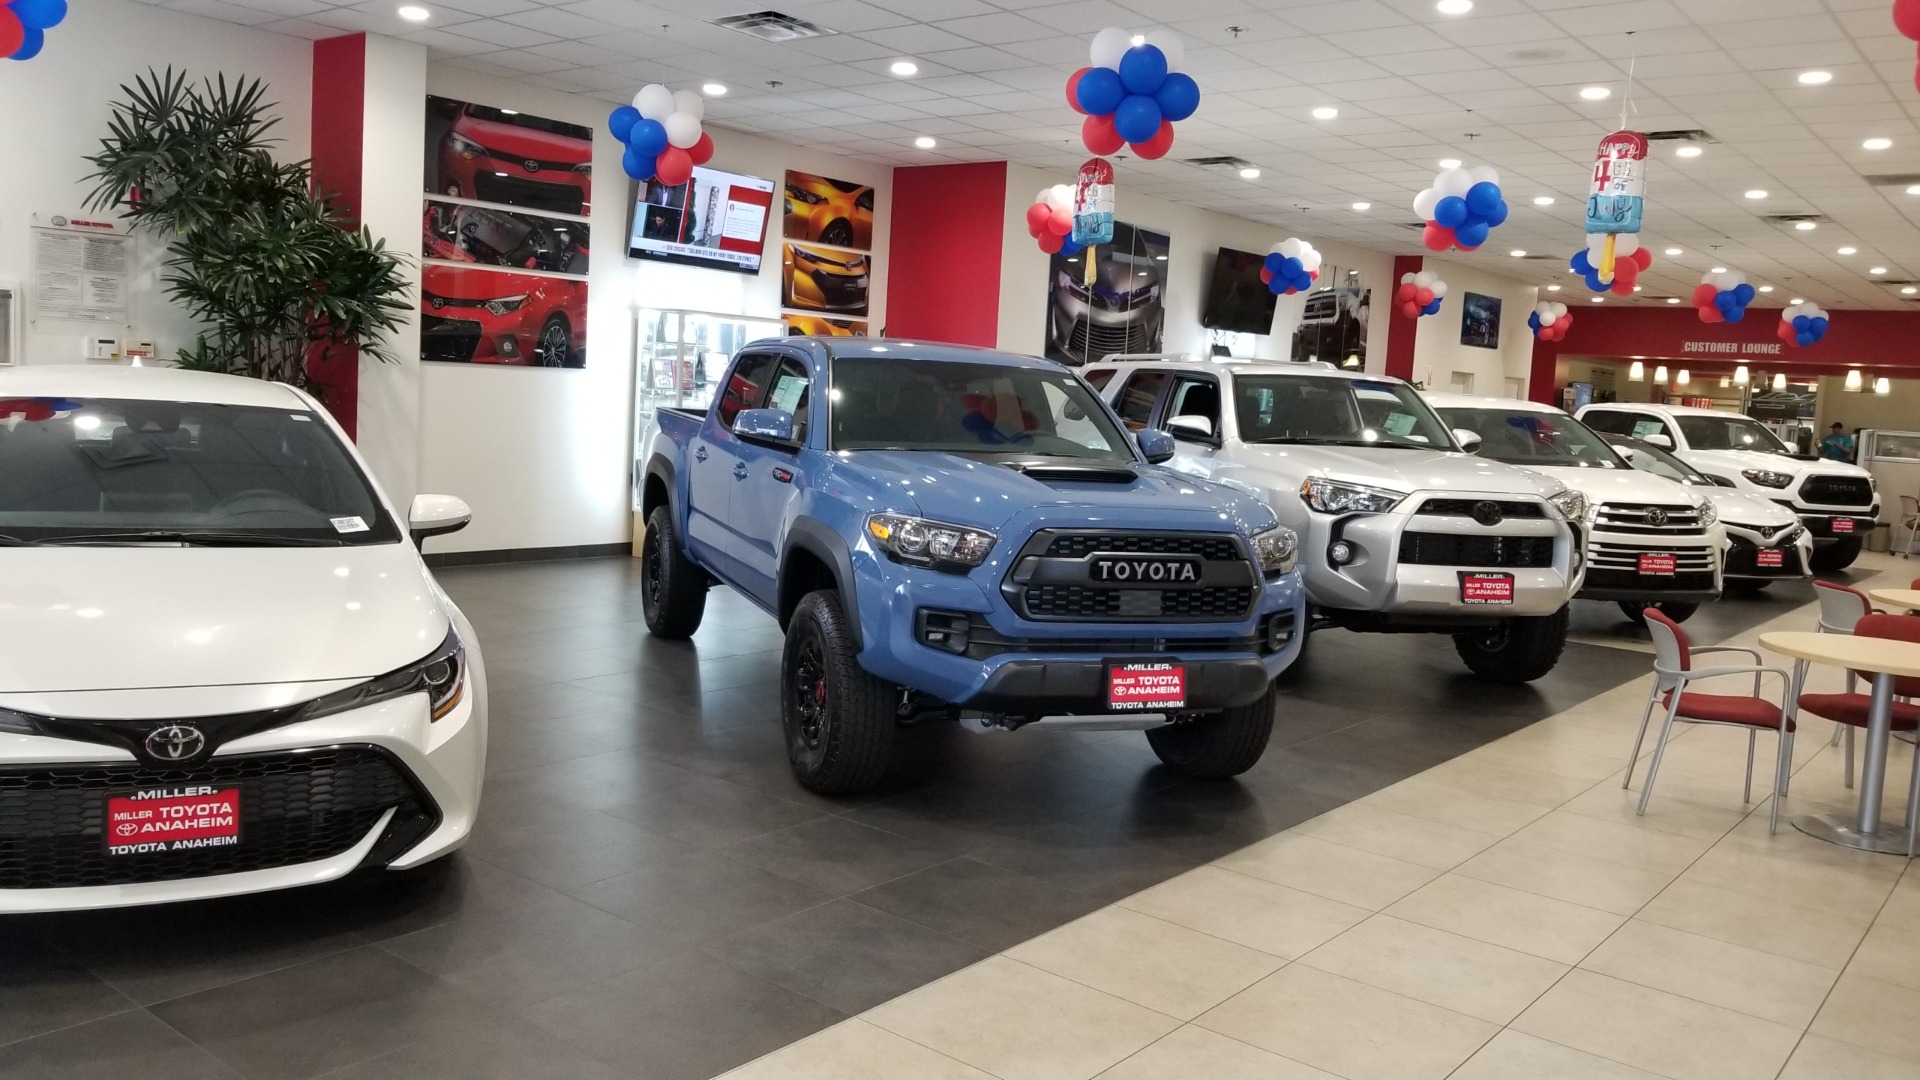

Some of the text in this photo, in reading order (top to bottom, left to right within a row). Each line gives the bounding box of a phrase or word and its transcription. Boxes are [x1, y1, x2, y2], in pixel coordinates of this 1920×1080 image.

[1600, 142, 1639, 157] HAPPY
[1594, 160, 1611, 191] 4
[1588, 196, 1632, 222] July
[1684, 341, 1781, 354] CUSTOMER LOUNGE
[1099, 561, 1195, 580] TOYOTA
[1127, 663, 1169, 671] MILLER
[1138, 676, 1180, 685] TOYOTA
[1127, 686, 1180, 694] ANAHEIM
[1111, 700, 1184, 709] TOYOTA ANAHEIM
[138, 786, 212, 800] MILLER
[114, 802, 233, 821] MILLER TOYOTA
[140, 816, 233, 833] ANAHEIM
[109, 835, 238, 855] TOYOTA ANAHEIM
